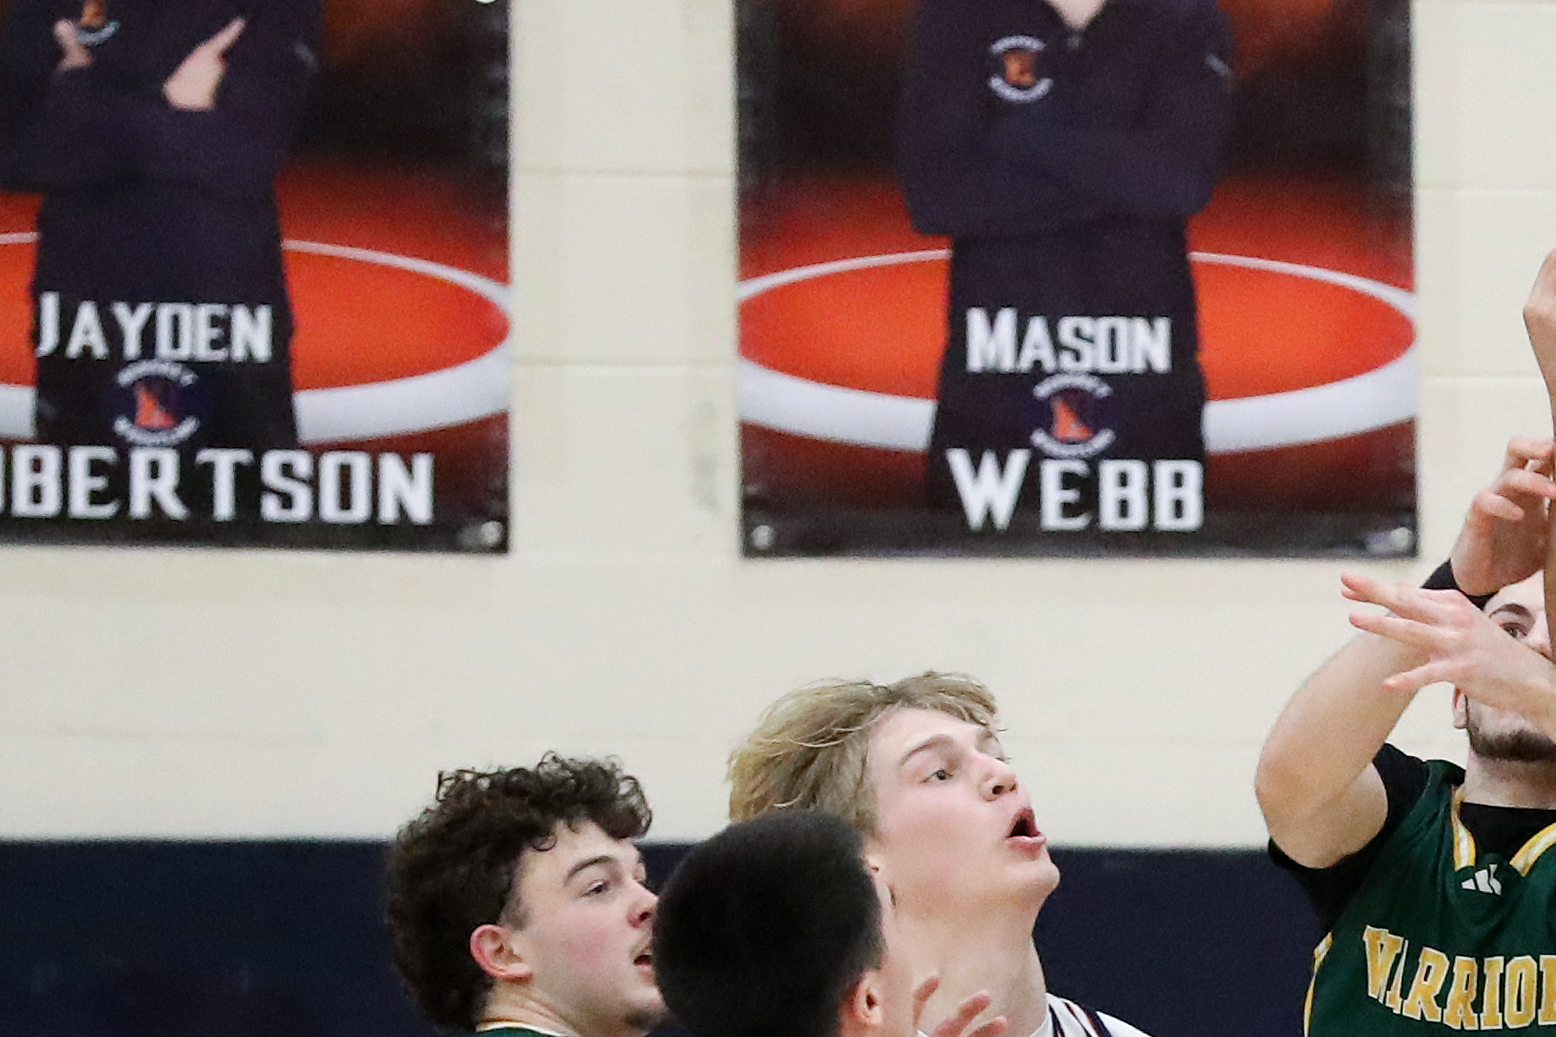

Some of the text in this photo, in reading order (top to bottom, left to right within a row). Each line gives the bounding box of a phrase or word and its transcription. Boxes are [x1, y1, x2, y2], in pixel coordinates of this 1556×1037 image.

[37, 291, 274, 363] JAYDEN
[966, 306, 1171, 374] MASON
[0, 444, 435, 525] BERTSON
[947, 447, 1204, 534] WEBB
